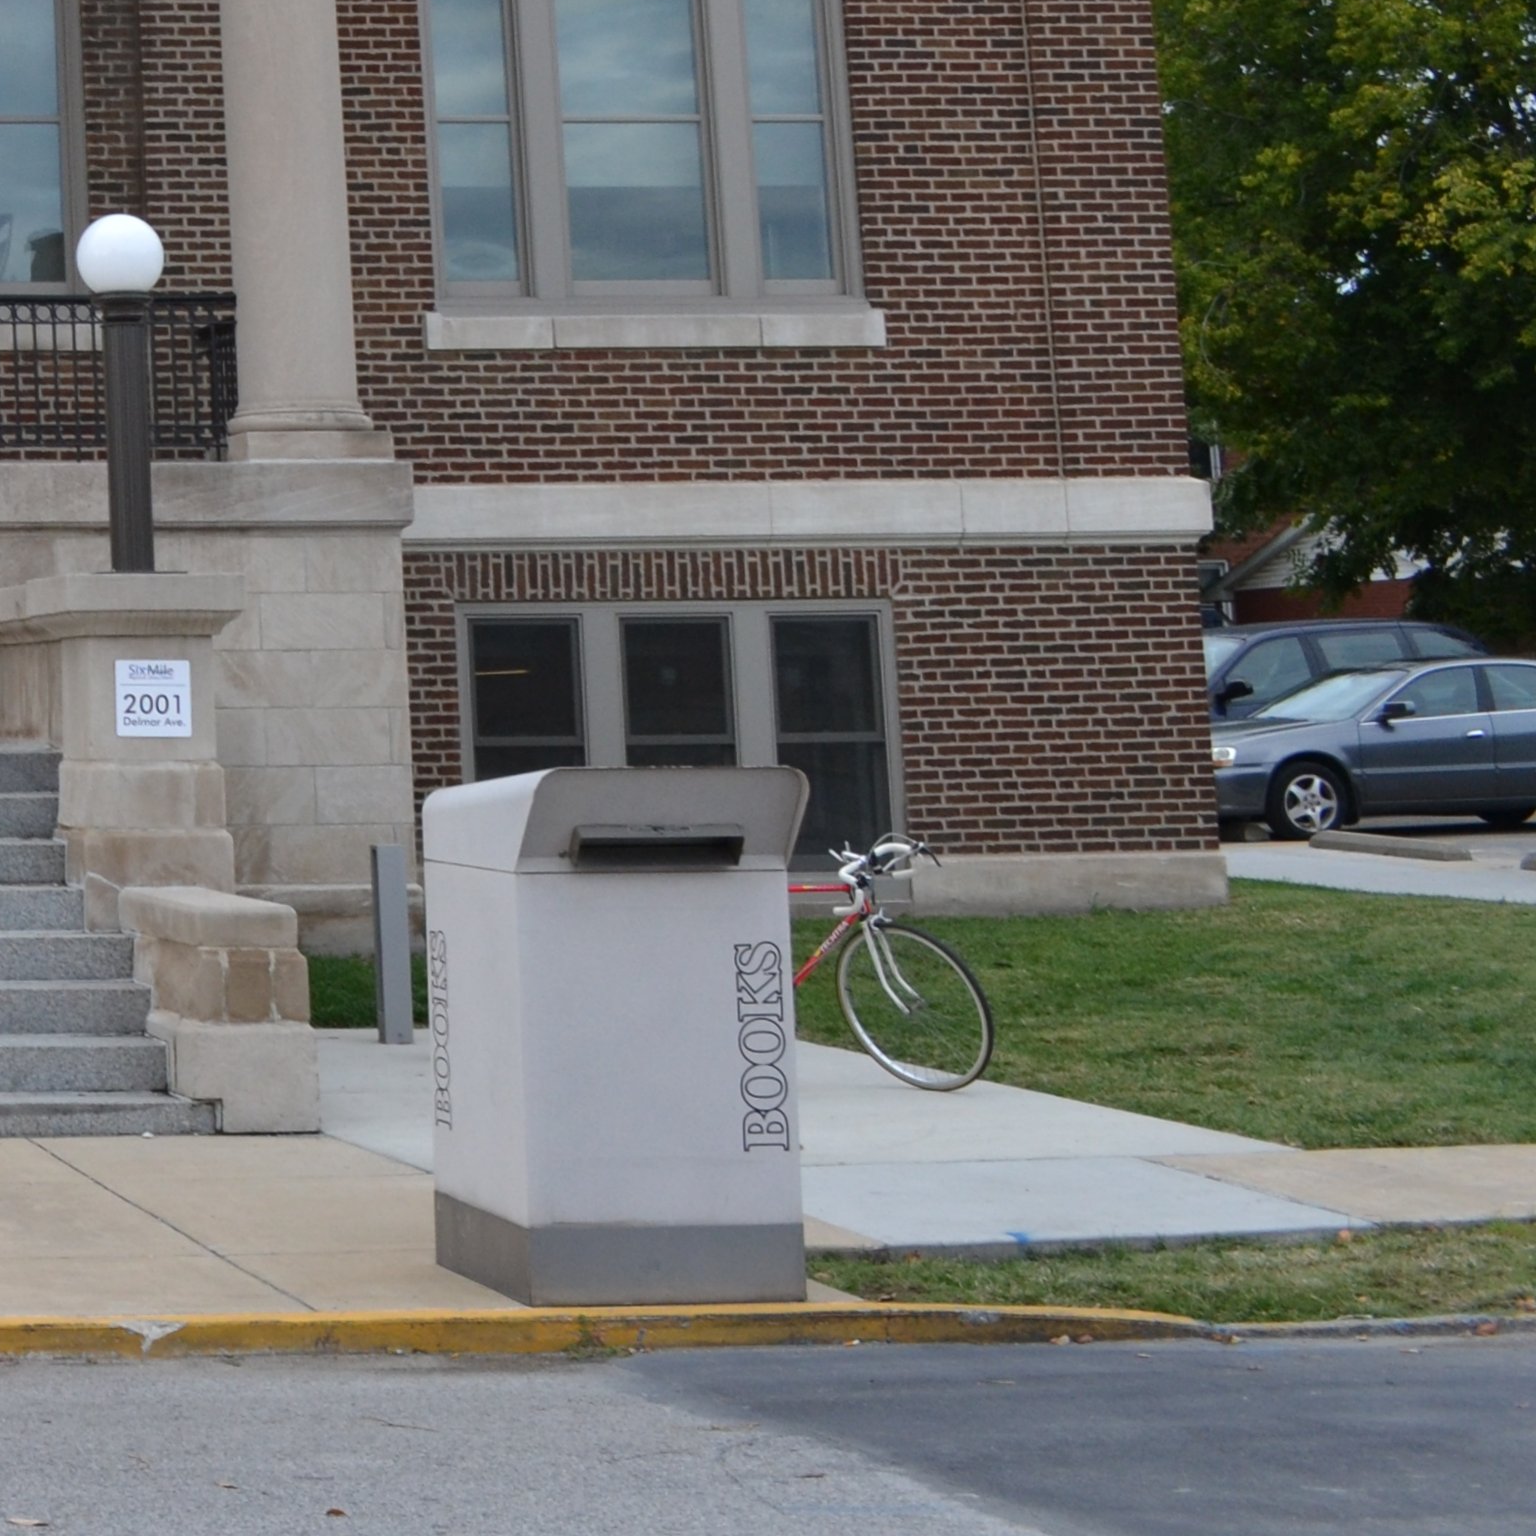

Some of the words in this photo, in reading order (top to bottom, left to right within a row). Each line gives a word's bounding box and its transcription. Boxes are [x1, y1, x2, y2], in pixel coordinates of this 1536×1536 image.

[123, 694, 180, 715] 2001
[123, 717, 160, 726] Delmar
[164, 718, 186, 727] Ave.
[429, 929, 453, 1132] BOOKS
[733, 940, 790, 1152] BOOKS
